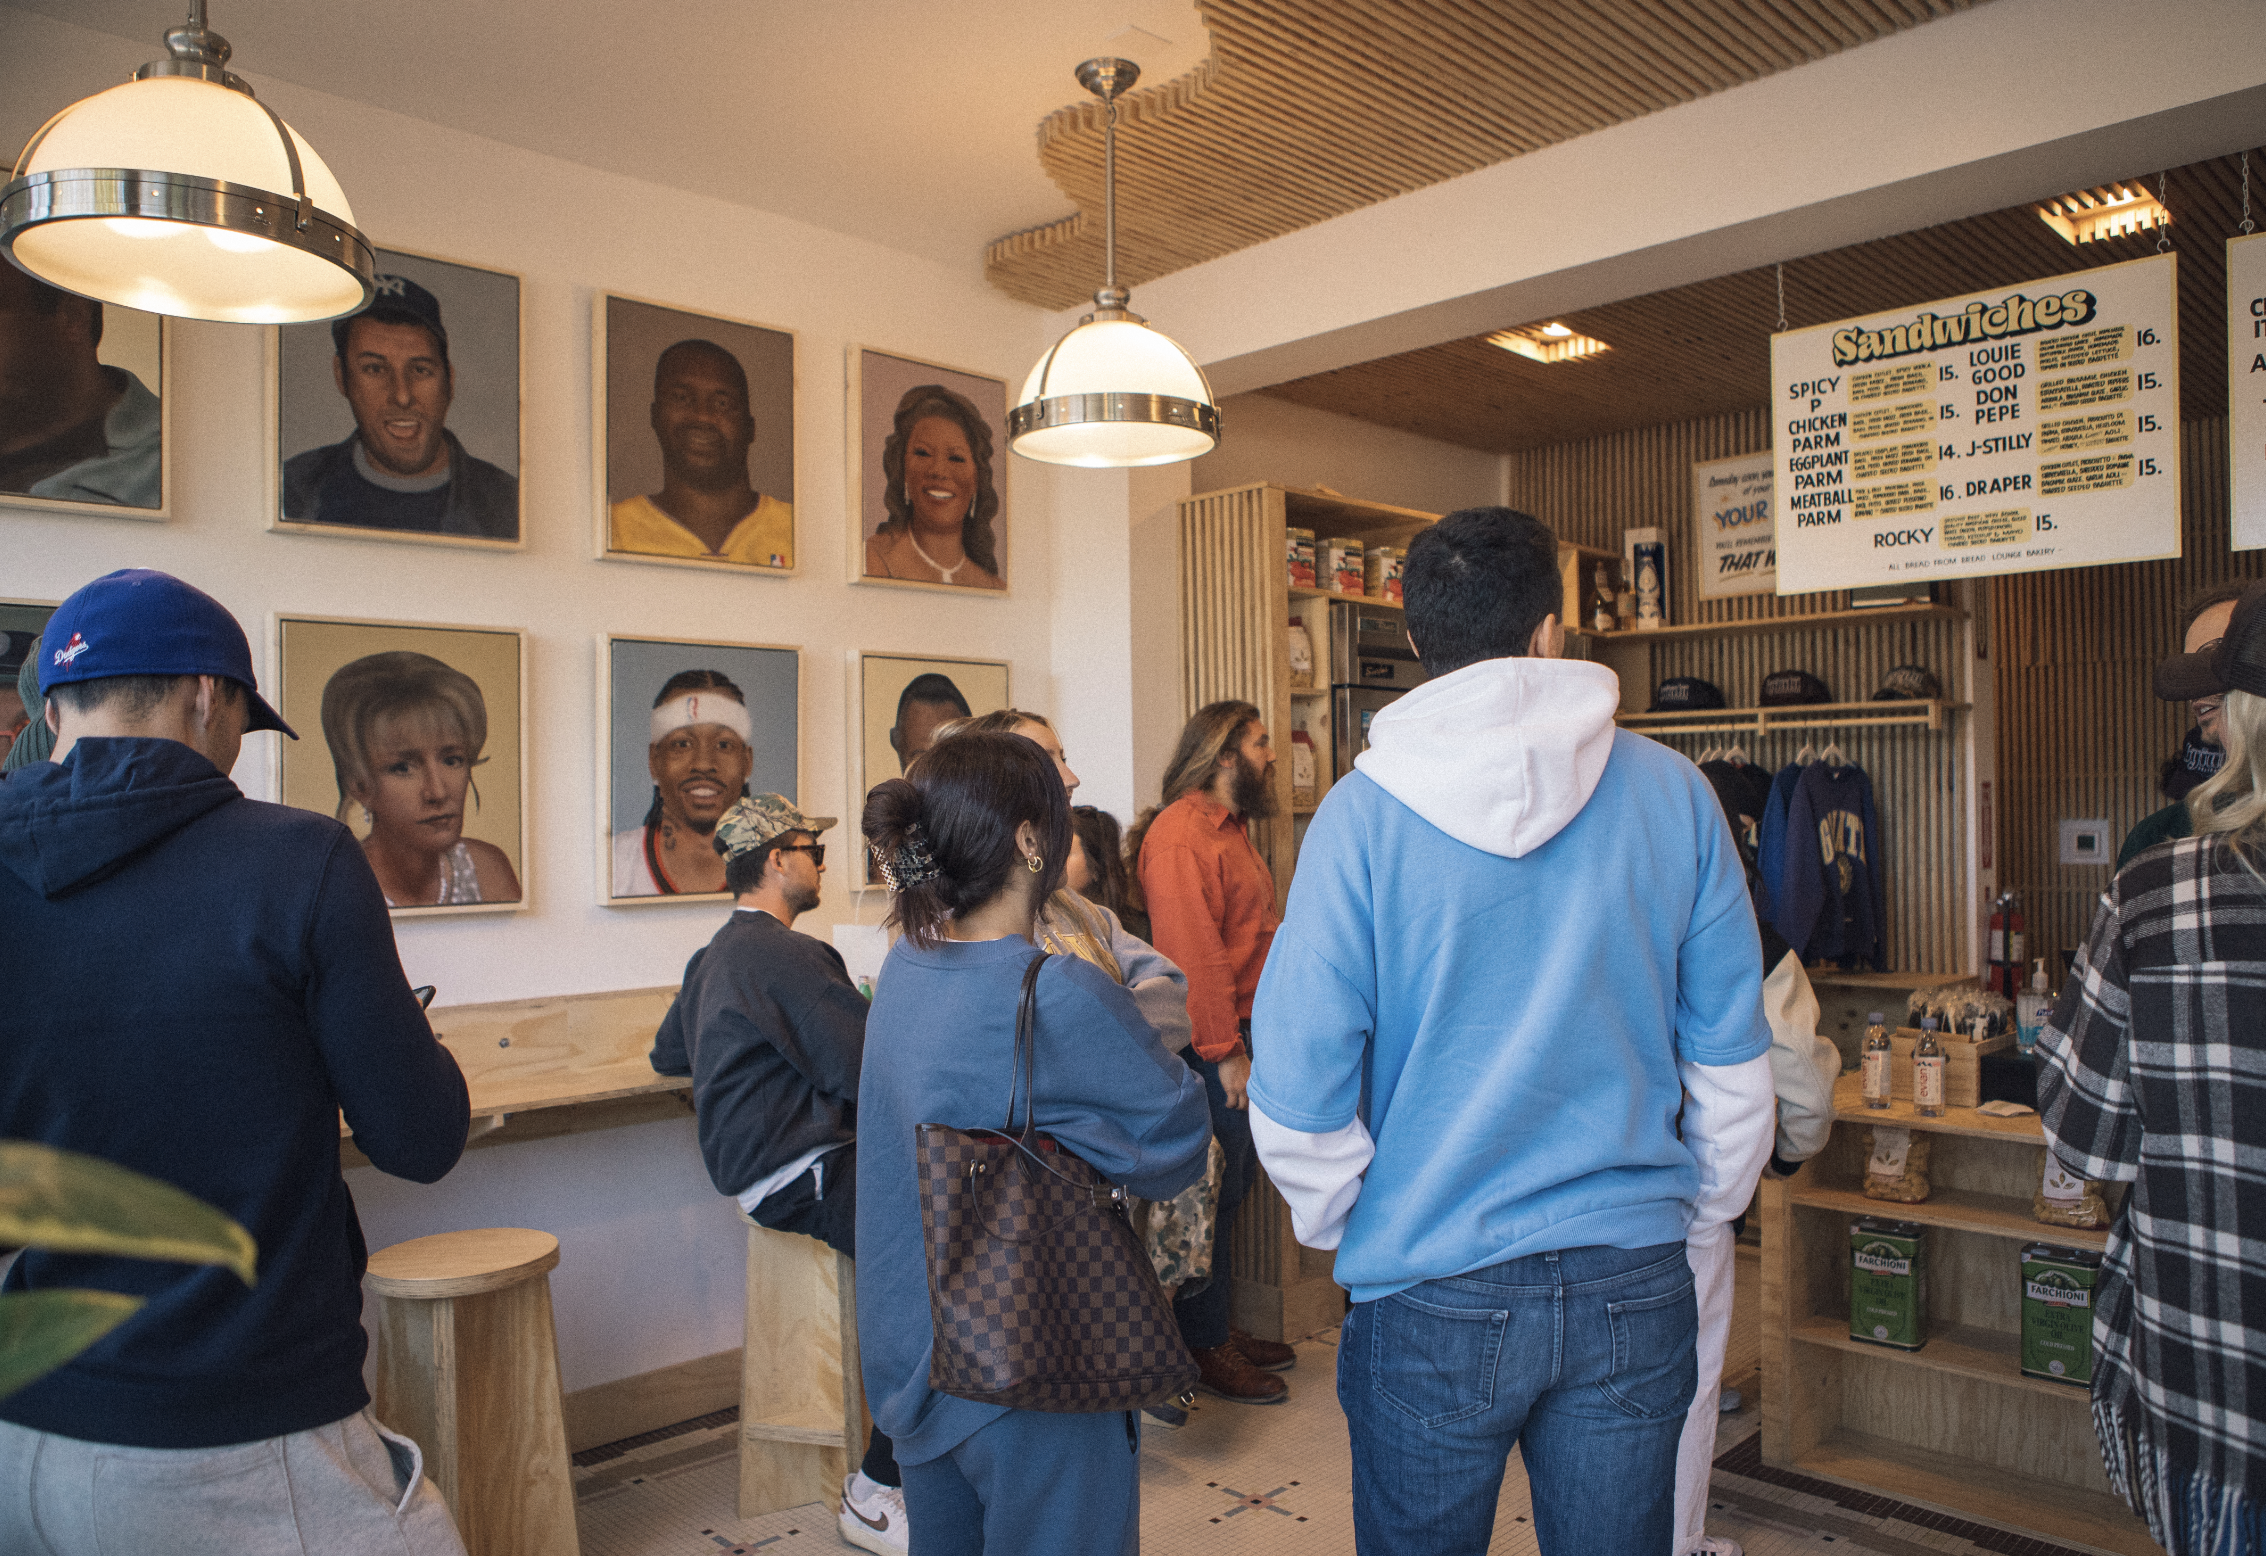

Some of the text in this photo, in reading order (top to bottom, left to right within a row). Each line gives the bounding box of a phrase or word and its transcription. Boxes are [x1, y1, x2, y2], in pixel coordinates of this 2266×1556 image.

[2250, 296, 2266, 318] C
[1832, 289, 2098, 368] Sandwiches
[2137, 328, 2161, 347] 16.
[1969, 343, 2022, 368] LOUIE
[1939, 365, 1959, 381] 15.
[1972, 362, 2026, 385] GOOD
[2138, 372, 2162, 390] 15.
[1789, 376, 1842, 400] SPICY
[1976, 384, 2018, 406] DON
[1810, 397, 1822, 413] P
[1939, 404, 1960, 420] 15.
[1975, 403, 2021, 425] PEPE
[1788, 412, 1848, 435] CHICKEN
[2138, 415, 2162, 433] 15.
[1792, 432, 1841, 453] PARM
[1939, 444, 1961, 460] 14.
[1966, 432, 2033, 457] J-STILLY
[1789, 450, 1850, 472] EGGPLANT
[2139, 458, 2162, 476] 15.
[1795, 469, 1843, 490] PARM
[1966, 474, 2032, 497] DRAPER
[1791, 489, 1855, 510] MEATBALL
[1714, 500, 1768, 531] YOUR
[1798, 509, 1842, 528] PARM
[2036, 514, 2058, 531] 15.
[1874, 527, 1934, 548] ROCKY
[1720, 550, 1764, 573] THAT
[1888, 547, 2056, 571] ALL BREAD FROM BREAD LOUNGE BAKERY
[1919, 1067, 1929, 1097] evian
[1859, 1255, 1907, 1270] FARCHIONI
[2031, 1285, 2085, 1301] FARCHIONI
[2031, 1317, 2085, 1334] VIRGIN OLIVE
[2045, 1309, 2071, 1322] EXTRA
